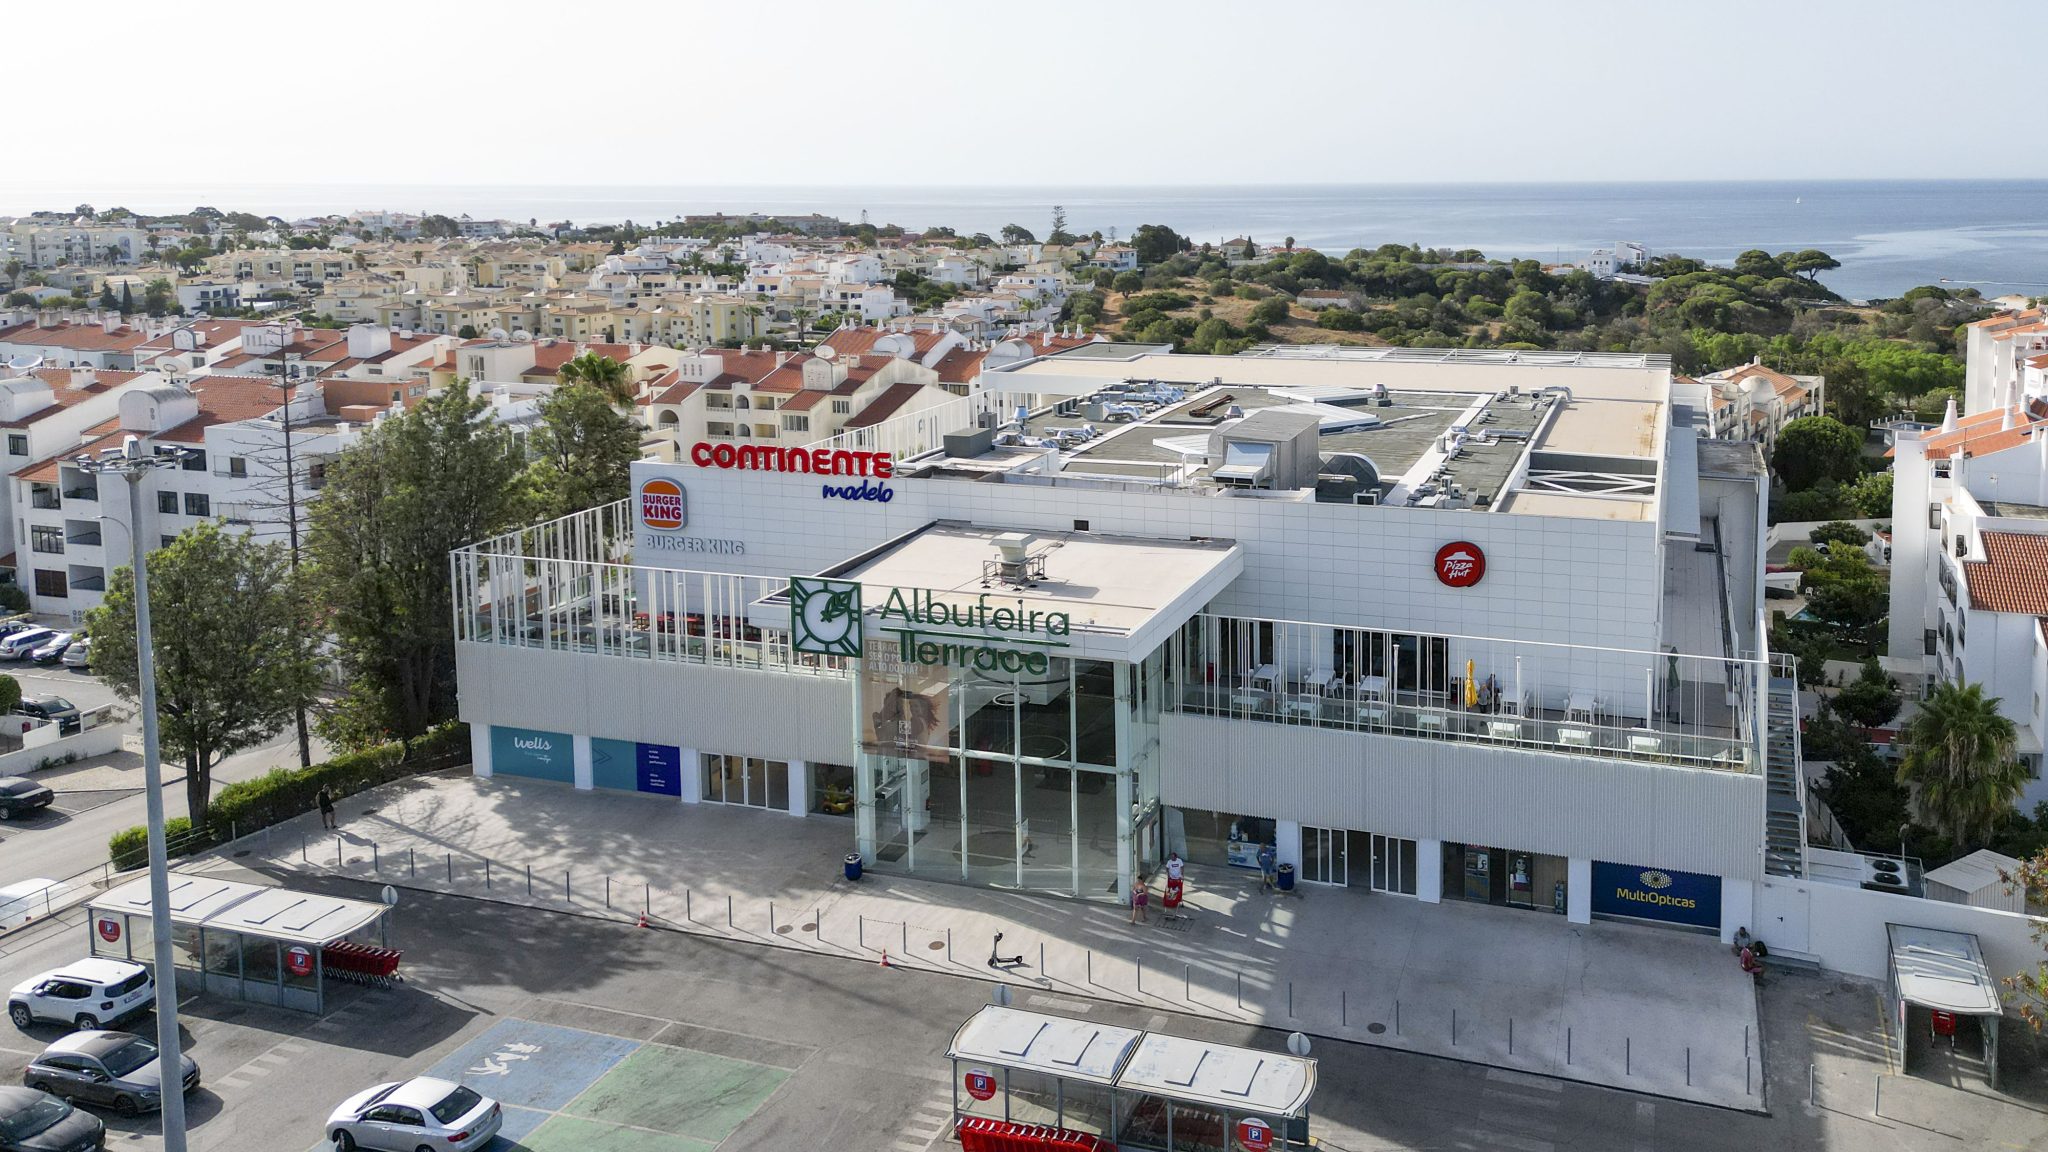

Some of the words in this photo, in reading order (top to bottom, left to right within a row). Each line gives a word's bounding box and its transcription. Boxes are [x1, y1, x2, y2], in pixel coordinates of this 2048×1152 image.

[690, 441, 893, 479] CONTINENTE
[822, 479, 894, 503] modelo
[642, 494, 682, 506] BURGER
[643, 504, 682, 520] KING
[646, 535, 704, 553] BURGER
[705, 538, 745, 555] KING
[1444, 560, 1473, 572] Pizza
[1448, 569, 1472, 579] Hut
[880, 586, 1071, 636] Albufeira
[1616, 888, 1696, 908] MultiOpticas
[977, 1080, 984, 1088] P
[1251, 1130, 1259, 1139] P
